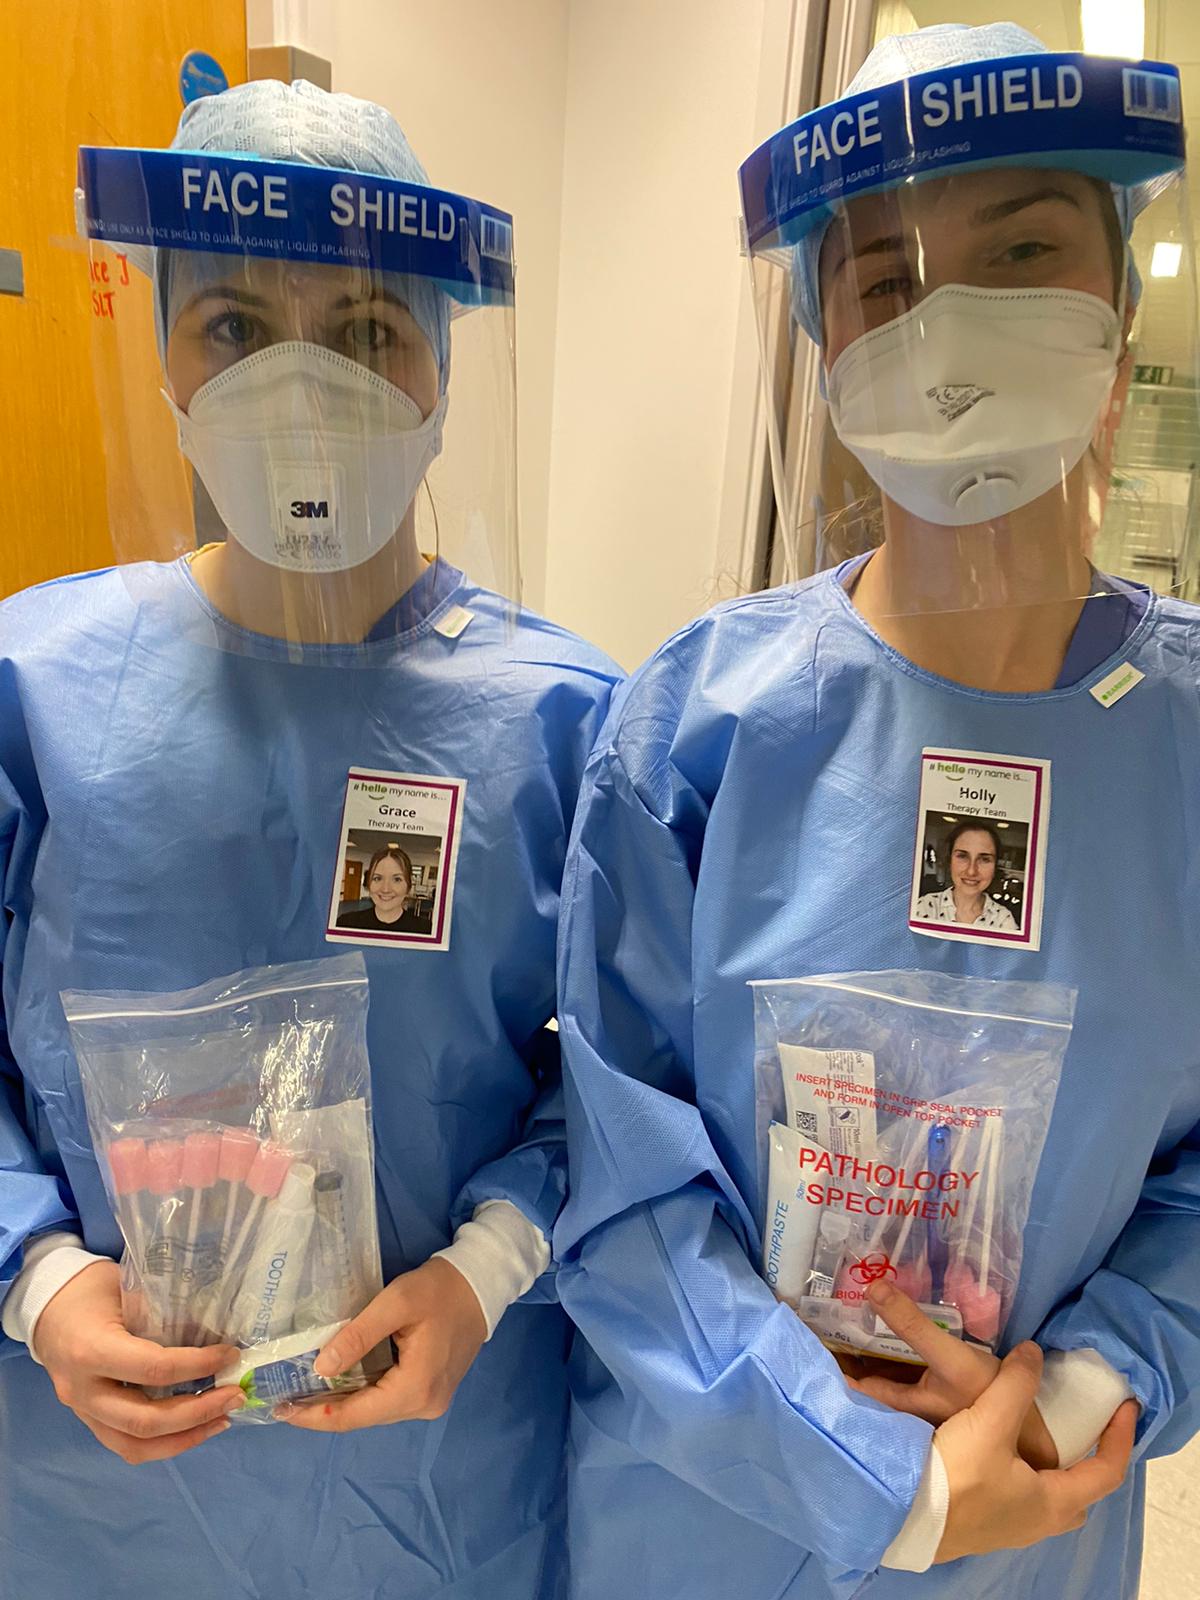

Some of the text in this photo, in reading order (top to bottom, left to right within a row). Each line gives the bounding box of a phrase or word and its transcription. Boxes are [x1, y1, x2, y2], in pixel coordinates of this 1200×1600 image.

[793, 65, 1083, 174] FACE SHIELD
[846, 164, 881, 185] AGAINST
[916, 141, 972, 162] SPLASHING
[182, 168, 456, 242] FACE SHIELD
[245, 238, 284, 250] AGAINST
[287, 240, 318, 253] LIQUID
[290, 500, 329, 519] 3M
[967, 767, 983, 778] my
[984, 769, 1012, 780] name
[388, 787, 404, 797] my
[404, 789, 429, 799] name
[960, 786, 997, 805] Holly
[379, 804, 417, 819] Grace
[946, 802, 1007, 818] Therapy Team
[367, 818, 425, 832] Therapy Team
[796, 1072, 832, 1088] INSERT
[834, 1079, 887, 1099] SPECIMEN
[889, 1092, 901, 1102] IN
[930, 1101, 957, 1113] SEAL
[960, 1106, 1003, 1117] POCKET
[813, 1088, 981, 1128] AND FORM IN OPEN TOP POCKET
[799, 1147, 980, 1192] PATHOLOGY
[806, 1184, 961, 1220] SPECIMEN
